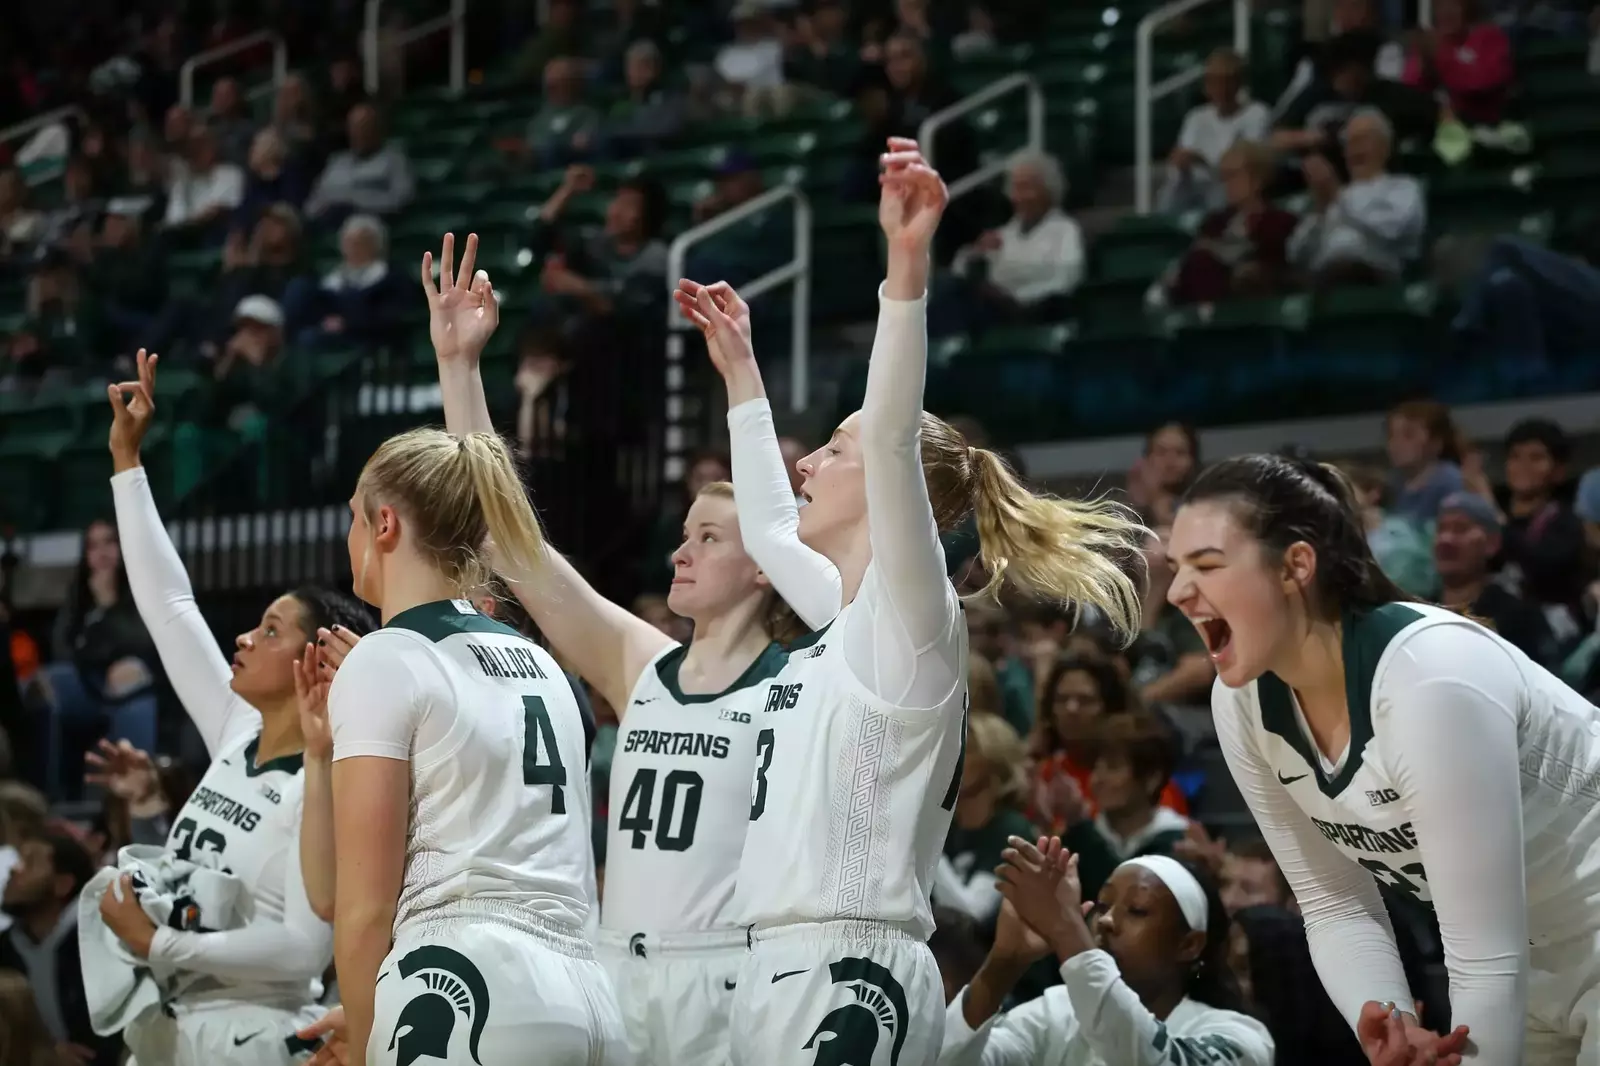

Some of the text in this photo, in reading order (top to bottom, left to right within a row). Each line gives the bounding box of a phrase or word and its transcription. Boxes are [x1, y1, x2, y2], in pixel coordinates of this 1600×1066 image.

[467, 644, 549, 680] HALLOCK
[521, 694, 567, 815] 4
[624, 730, 731, 759] SPARTANS
[618, 768, 704, 853] 40
